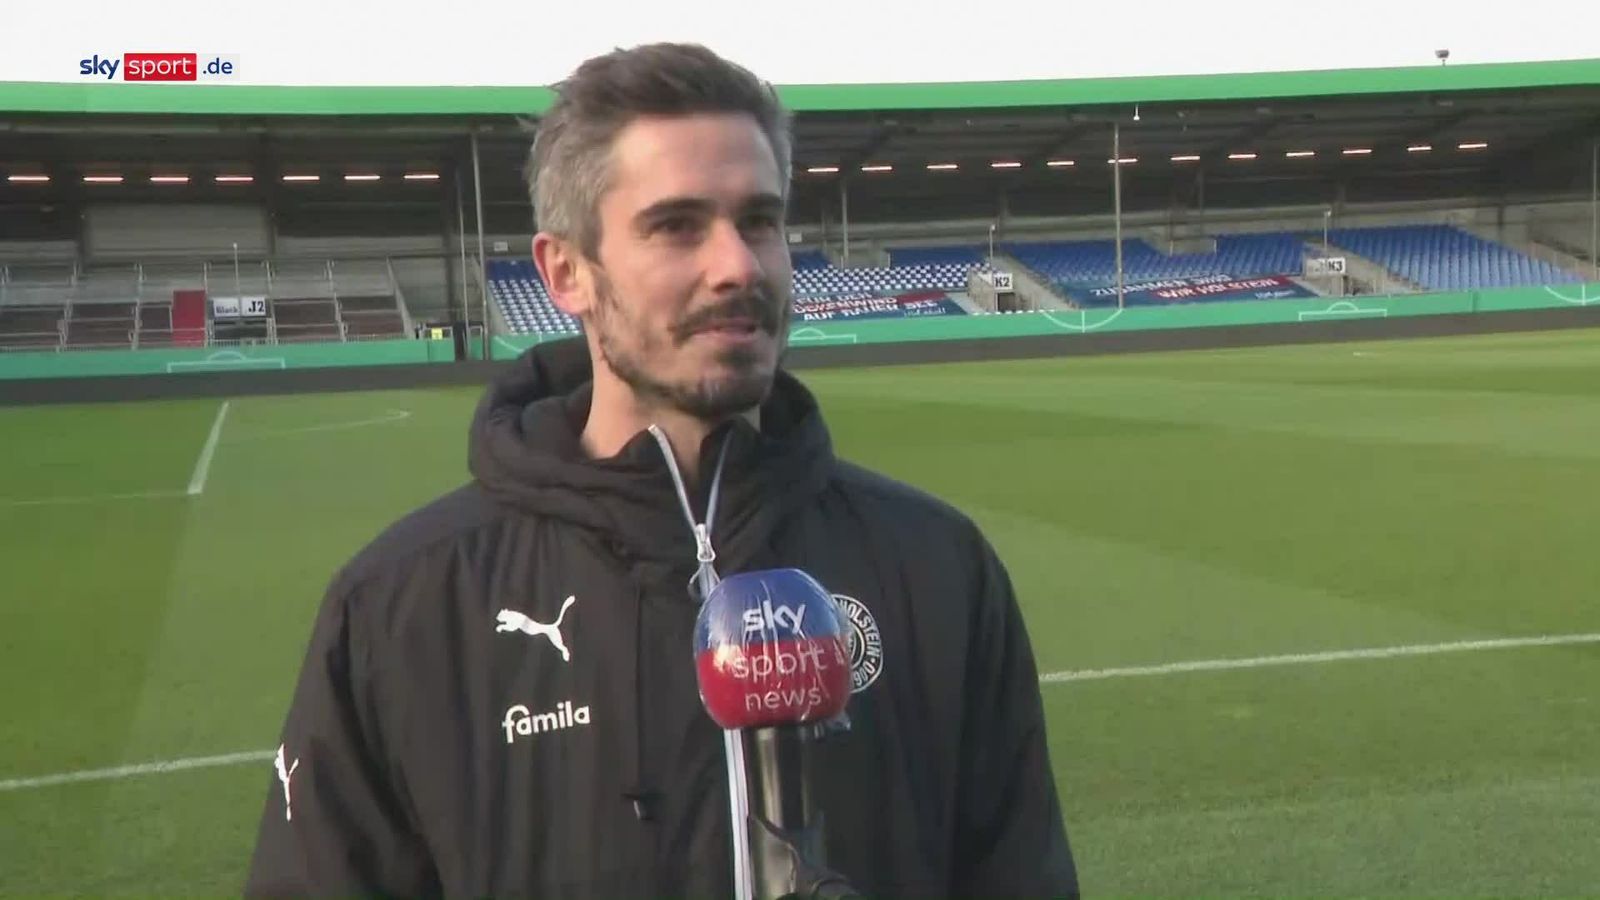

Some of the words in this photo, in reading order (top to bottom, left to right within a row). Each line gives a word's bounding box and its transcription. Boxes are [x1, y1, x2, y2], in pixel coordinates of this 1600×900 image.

[1328, 260, 1343, 271] K3
[995, 277, 1010, 287] K2
[1198, 278, 1280, 295] HOLSTEIN
[248, 300, 265, 312] J2
[793, 297, 898, 314] ÜCKENWIND
[742, 599, 806, 634] sky
[731, 645, 828, 684] sport
[746, 686, 822, 712] news
[501, 700, 591, 744] famila
